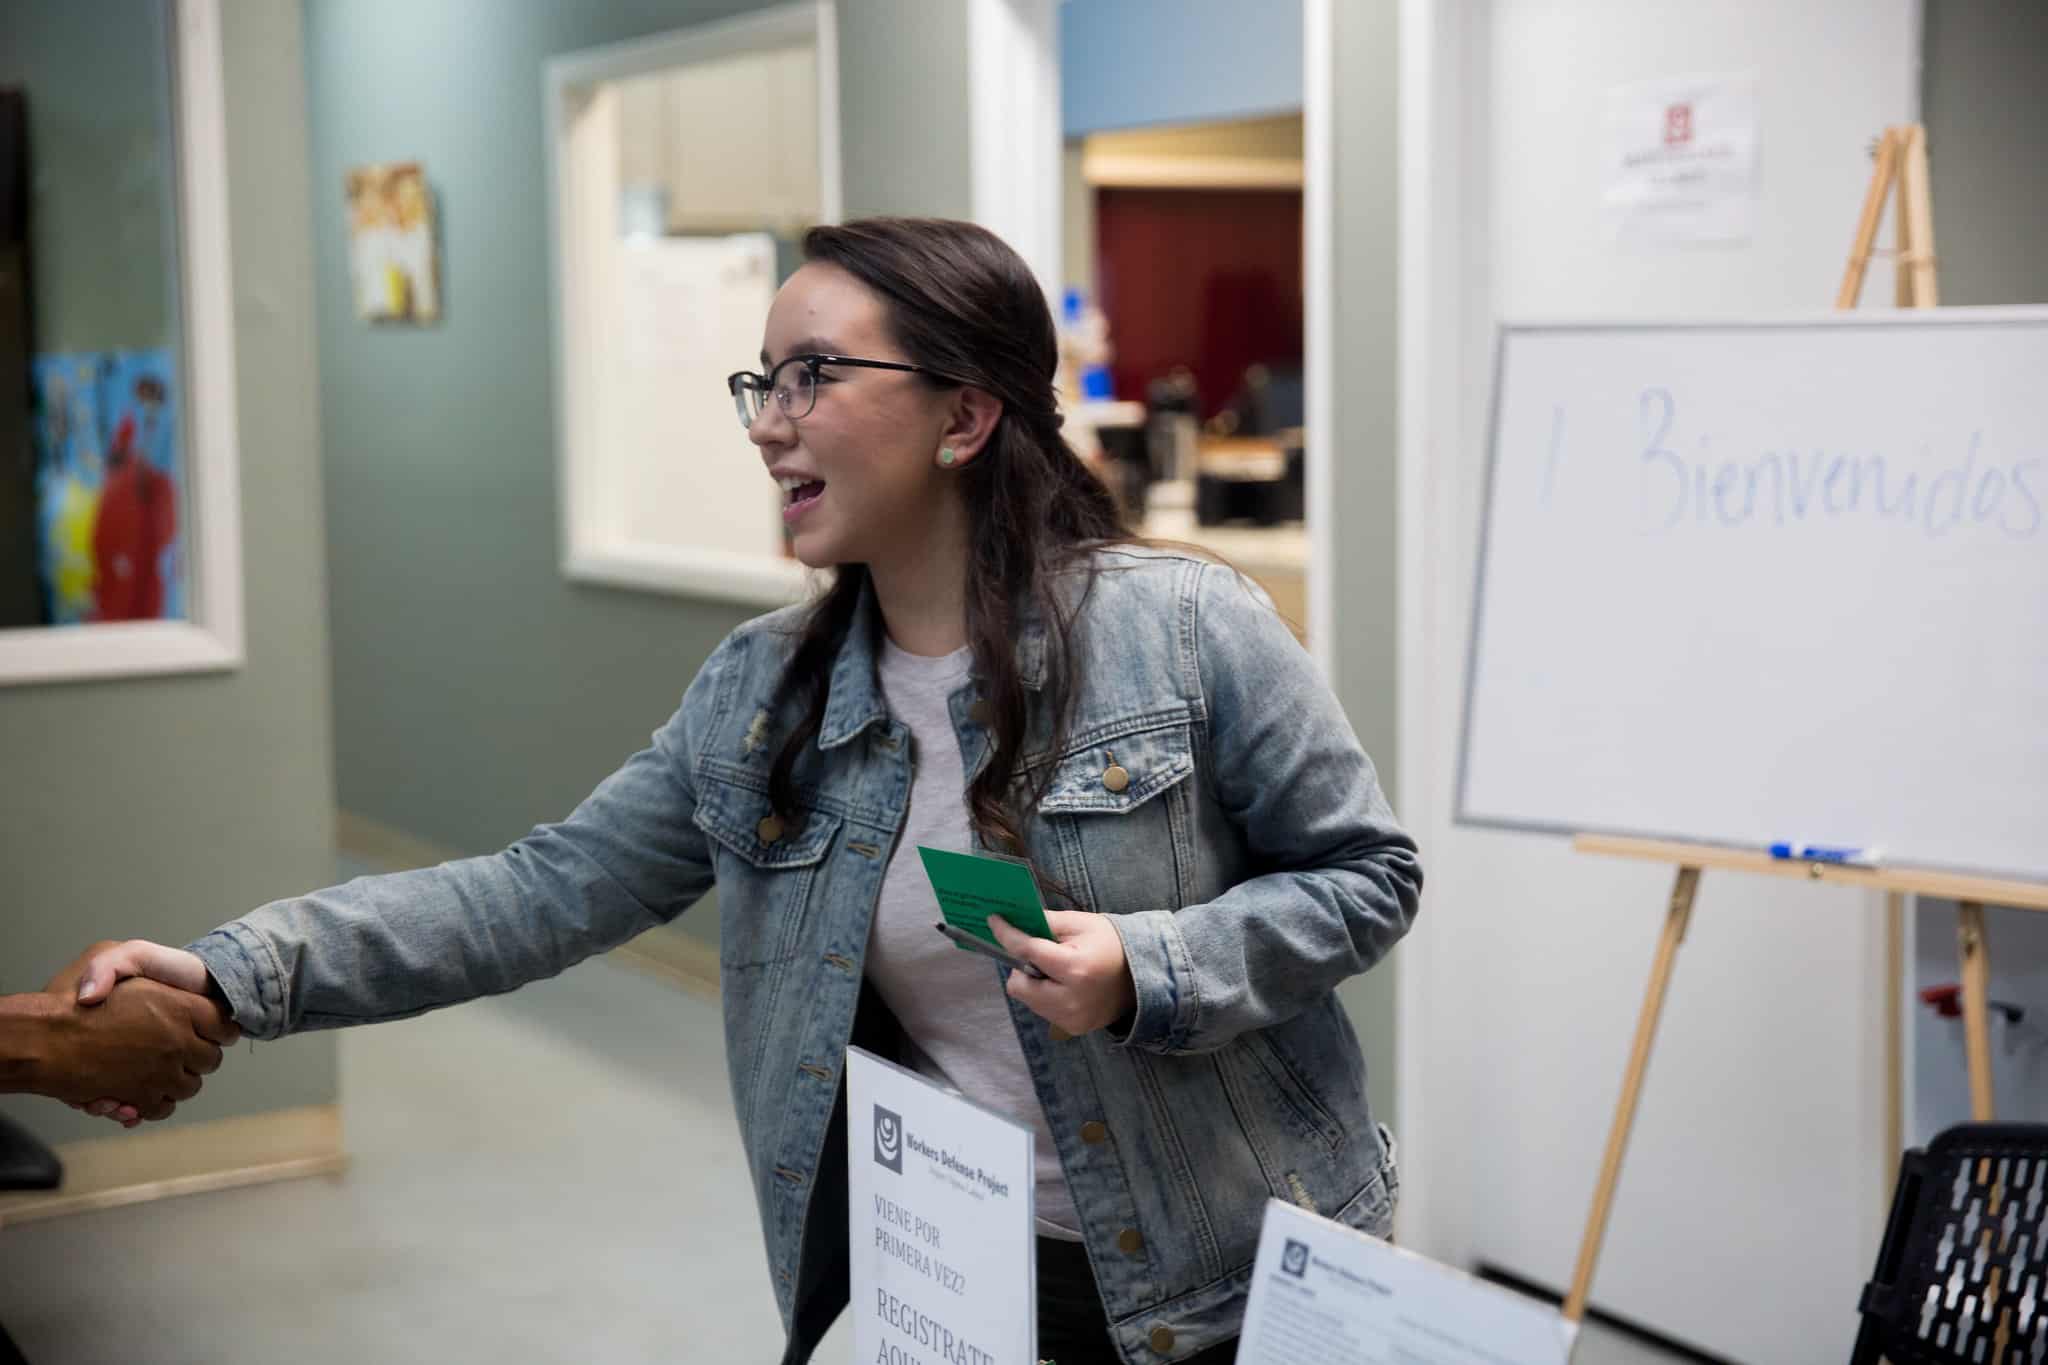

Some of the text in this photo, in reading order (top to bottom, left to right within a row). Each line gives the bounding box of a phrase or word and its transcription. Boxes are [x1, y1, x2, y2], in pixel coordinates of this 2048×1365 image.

[1633, 384, 2041, 538] Bienvenidos
[905, 1132, 939, 1162] Workers
[941, 1148, 975, 1181] Defense
[977, 1167, 1008, 1198] Project
[875, 1193, 941, 1249] VIENE POR
[875, 1226, 967, 1296] PRIMERA VEZ?
